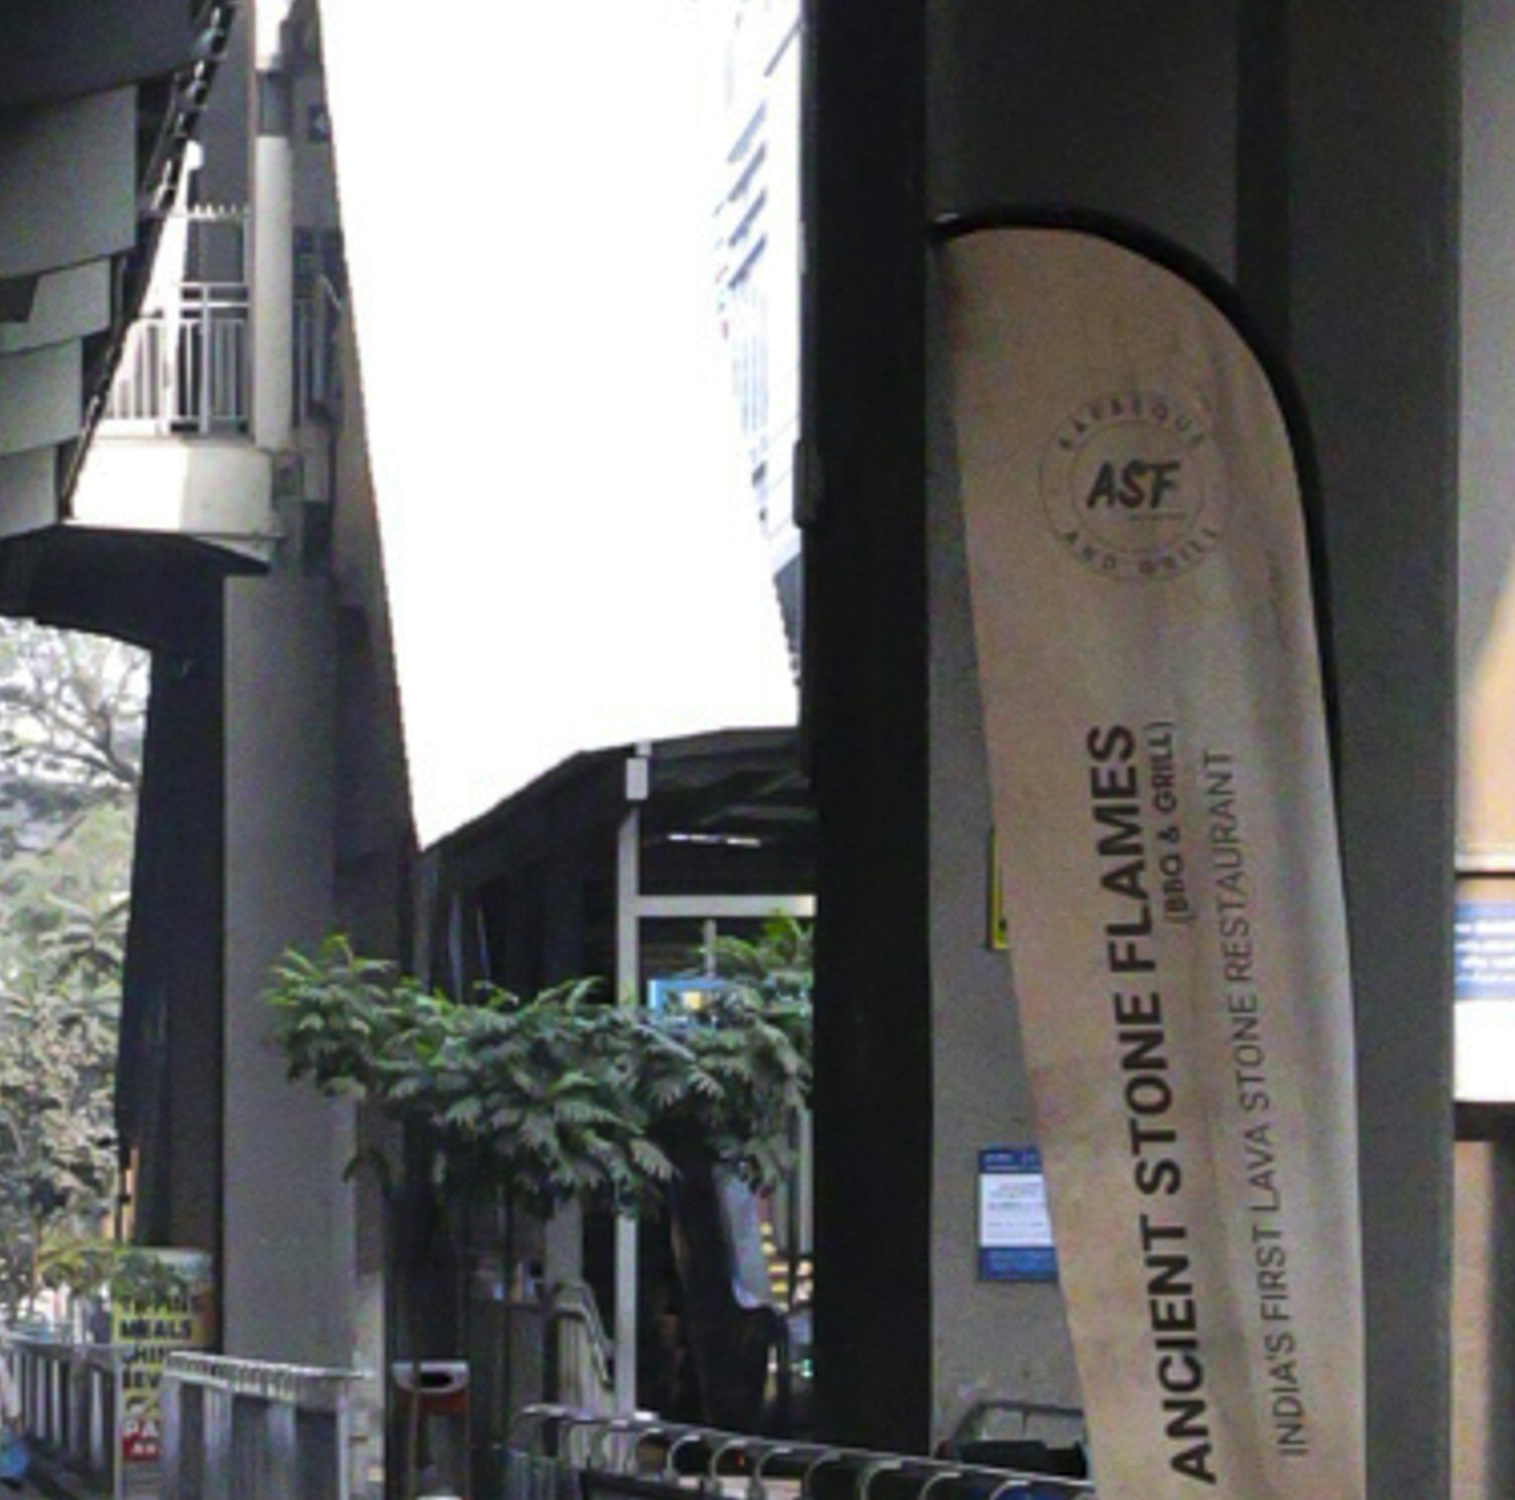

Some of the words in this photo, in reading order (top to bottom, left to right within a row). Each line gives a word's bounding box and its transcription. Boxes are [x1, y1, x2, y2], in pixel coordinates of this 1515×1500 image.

[1086, 459, 1181, 509] ASF
[1145, 721, 1178, 814] GRILL)
[1086, 724, 1157, 973] FLAMES
[1157, 825, 1180, 844] &
[1204, 752, 1254, 983] RESTAURANT
[1158, 853, 1197, 925] (BBQ
[1114, 992, 1182, 1196] STONE
[1228, 992, 1270, 1112] STONE
[1243, 1123, 1281, 1213] LAVA
[1252, 1225, 1291, 1321] FIRST
[121, 1318, 192, 1339] MEALS
[1140, 1213, 1217, 1486] ANCIENT
[1265, 1331, 1308, 1457] INDIA'S
